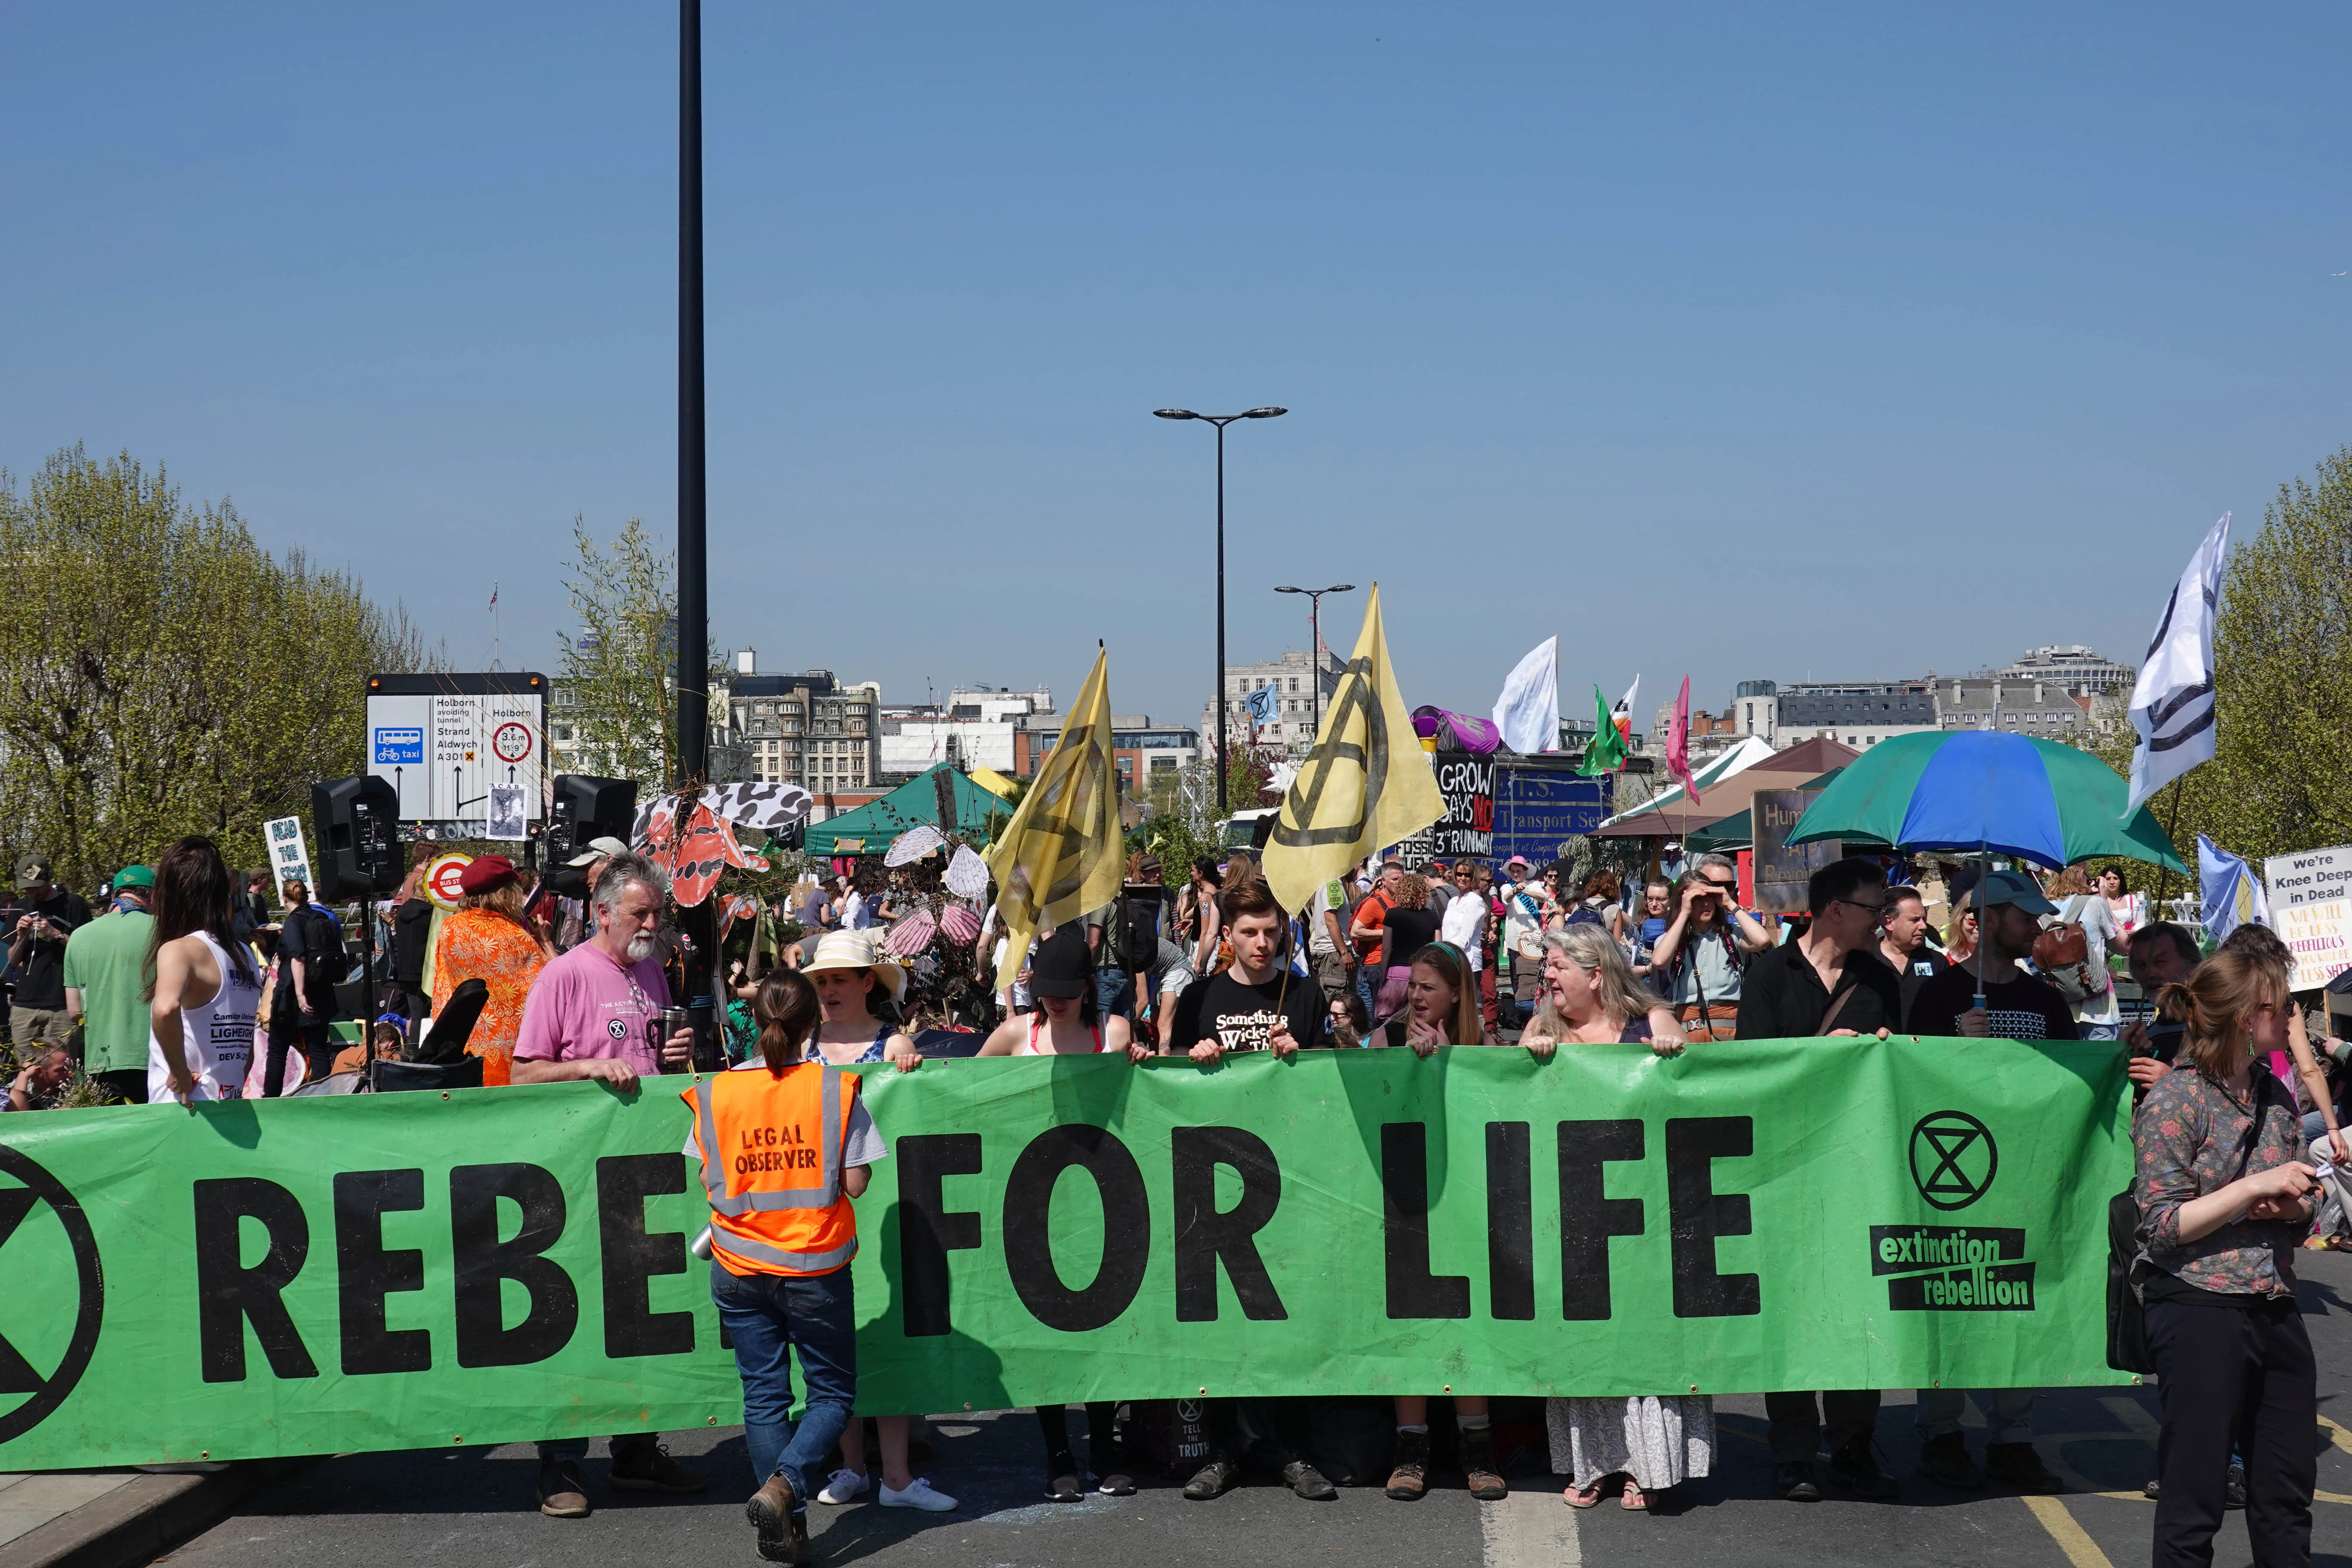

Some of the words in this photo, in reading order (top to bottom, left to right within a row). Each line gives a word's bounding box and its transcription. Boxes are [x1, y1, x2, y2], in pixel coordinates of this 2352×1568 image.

[402, 750, 419, 758] taxi
[437, 741, 477, 750] Aldwych
[1440, 762, 1494, 795] GROW
[1473, 795, 1493, 830] NO
[1500, 811, 1571, 831] Transport
[1578, 812, 1602, 828] Ser
[1765, 804, 1804, 826] Hum
[272, 820, 297, 842] READ
[1451, 829, 1494, 856] RUNWAY
[1522, 842, 1529, 851] at
[278, 844, 298, 862] THE
[280, 863, 307, 882] SIGNS
[2275, 876, 2311, 889] Knee
[2316, 870, 2352, 883] Deep
[2291, 893, 2303, 903] in
[2309, 885, 2344, 901] Dead
[2290, 908, 2309, 923] WE
[2312, 903, 2344, 921] WILL
[2289, 926, 2304, 939] BE
[2309, 922, 2337, 937] LESS
[2289, 935, 2344, 953] REBELLIOUS
[2300, 954, 2316, 965] YOU
[2300, 966, 2325, 983] LESS
[1216, 1010, 1288, 1030] Something
[741, 1124, 804, 1149] LEGAL
[735, 1148, 817, 1175] OBSERVER
[193, 1152, 735, 1383] REBE
[896, 1123, 1289, 1337] FOR
[1380, 1116, 1761, 1320] LIFE
[1879, 1228, 2000, 1264] extinction
[1923, 1267, 2028, 1305] rebellion
[1182, 1424, 1201, 1434] TELL
[1178, 1442, 1210, 1457] TRUTH
